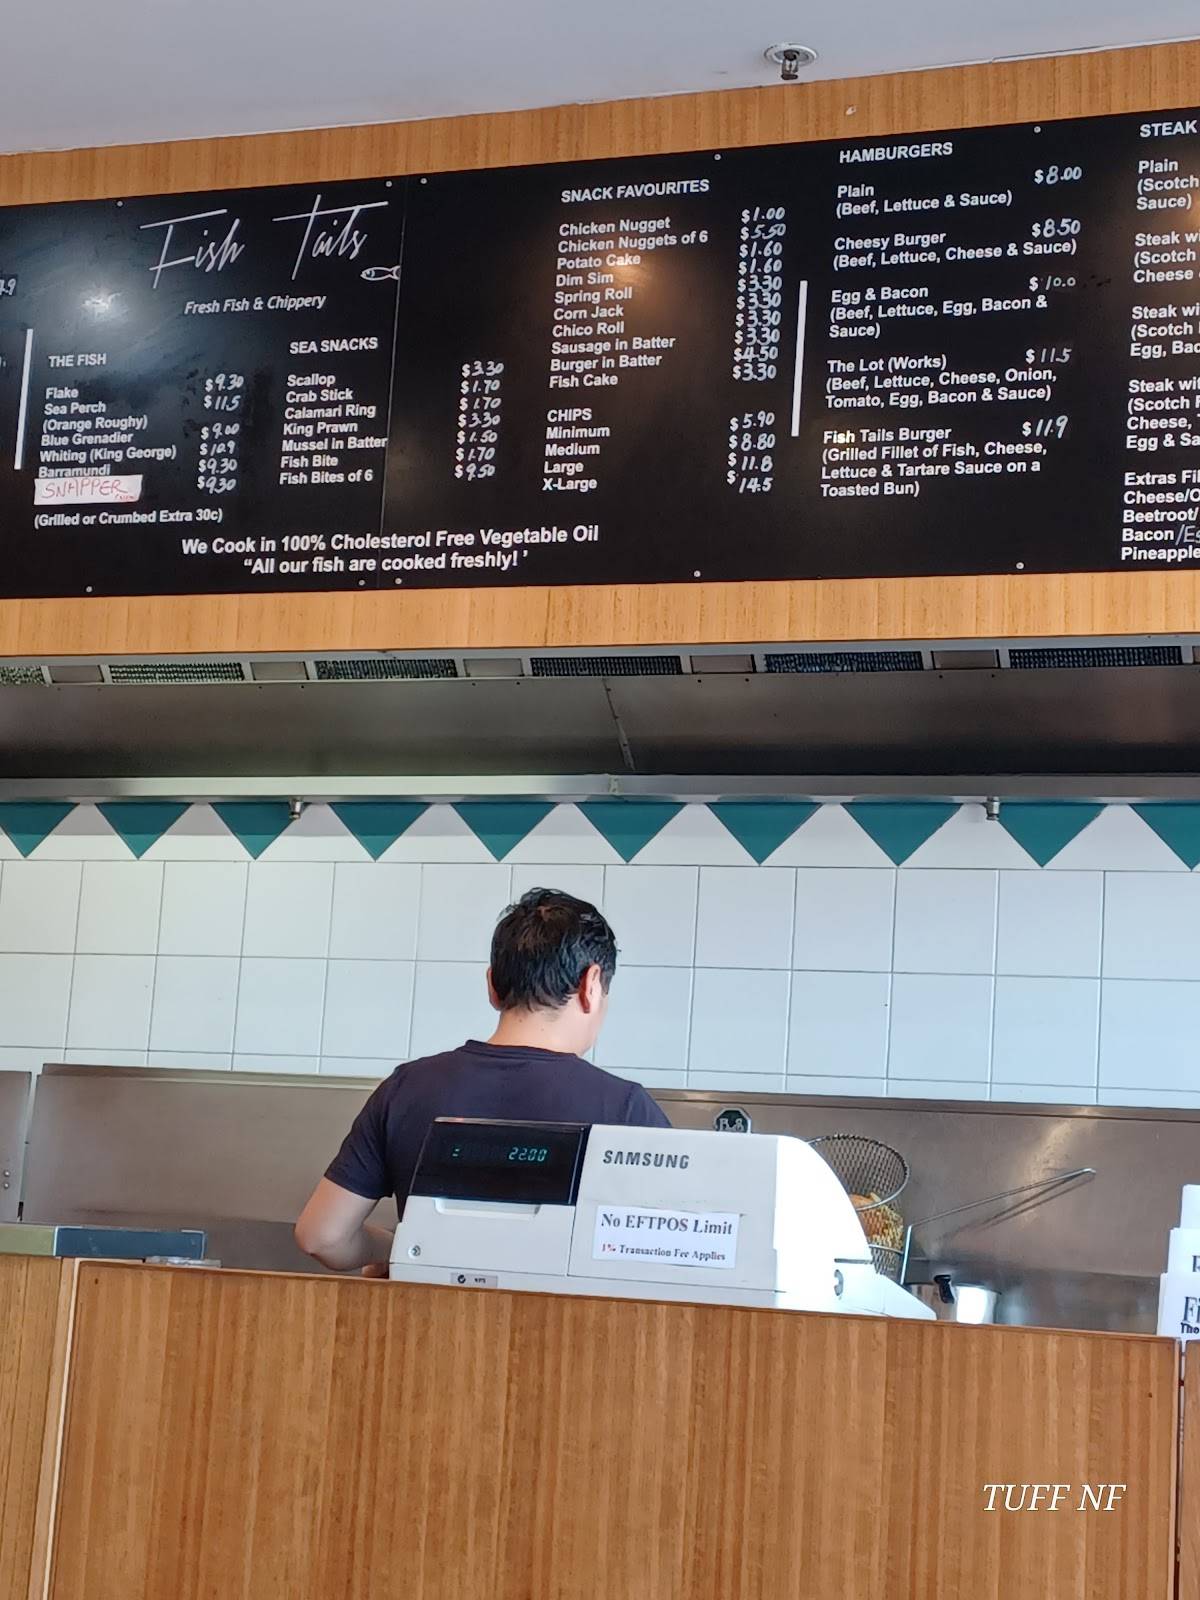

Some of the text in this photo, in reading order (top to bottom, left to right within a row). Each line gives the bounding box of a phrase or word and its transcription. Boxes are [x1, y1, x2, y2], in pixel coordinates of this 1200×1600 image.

[1140, 120, 1197, 137] STEAK
[840, 142, 953, 163] HAMBURGERS
[1138, 158, 1178, 174] Plain
[561, 179, 709, 203] SNACK FAVOURITES
[837, 184, 874, 198] Plain
[1137, 175, 1199, 195] (Scotch
[836, 190, 1012, 219] (Beef, Lettuce & Sauce)
[1136, 193, 1192, 210] Sauce)
[559, 217, 670, 236] Chicken Nugget
[140, 194, 389, 290] Fish Tails
[558, 230, 708, 253] Chicken Nuggets of 6
[834, 233, 946, 250] Cheesy Burger
[1135, 231, 1180, 247] Steak
[557, 253, 641, 270] Potato Cake
[833, 238, 1077, 271] (Beef, Lettuce, Cheese & Sauce)
[1134, 248, 1196, 268] (Scotch
[556, 272, 614, 287] Dim Sim
[1133, 269, 1194, 283] Cheese
[554, 286, 632, 306] Spring Roll
[831, 287, 928, 305] Egg & Bacon
[184, 295, 327, 314] Fresh Fish & Chippery
[554, 304, 624, 320] Corn Jack
[1132, 304, 1177, 319] Steak
[552, 321, 624, 337] Chico Roll
[290, 337, 378, 354] SEA SNACKS
[551, 336, 676, 355] Sausage in Batter
[48, 353, 107, 367] THE FISH
[550, 354, 662, 373] Burger in Batter
[827, 354, 946, 373] The Lot (Works)
[287, 373, 336, 387] Scallop
[549, 373, 618, 388] Fish Cake
[1128, 378, 1174, 393] Steak
[46, 387, 79, 399] Flake
[286, 388, 353, 403] Crab Stick
[44, 401, 106, 415] Sea Perch
[285, 404, 376, 419] Calamari Ring
[547, 408, 592, 422] CHIPS
[43, 414, 148, 434] (Orange Roughy)
[283, 422, 358, 437] King Prawn
[1127, 416, 1192, 430] Cheese,
[41, 431, 134, 446] Blue Grenadier
[546, 426, 610, 439] Minimum
[823, 427, 952, 444] Fish Tails Burger
[282, 436, 388, 452] Mussel in Batter
[545, 442, 600, 456] Medium
[40, 445, 177, 464] Whiting (King George)
[280, 454, 338, 468] Fish Bite
[822, 441, 1047, 465] (Grilled Fillet of Fish, Cheese,
[38, 464, 111, 479] Barramundi
[544, 461, 584, 476] Large
[279, 469, 373, 485] Fish Bites of 6
[542, 478, 597, 492] X-Large
[1124, 472, 1177, 486] Extras
[42, 478, 128, 500] SNAPPER
[820, 481, 920, 497] Toasted Bun)
[34, 508, 223, 529] (Grilled or Crumbed Extra 30c)
[182, 525, 599, 554] We Cook in 100% Cholesterol Free Vegetable Oil
[1122, 528, 1174, 542] Bacon
[279, 556, 309, 573] our
[312, 556, 344, 572] fish
[348, 554, 376, 571] are
[382, 553, 446, 571] cooked
[603, 1150, 689, 1169] SAMSUNG
[601, 1213, 732, 1235] No EFTPOS Limit
[602, 1243, 726, 1262] 1% Transaction Fee Applies
